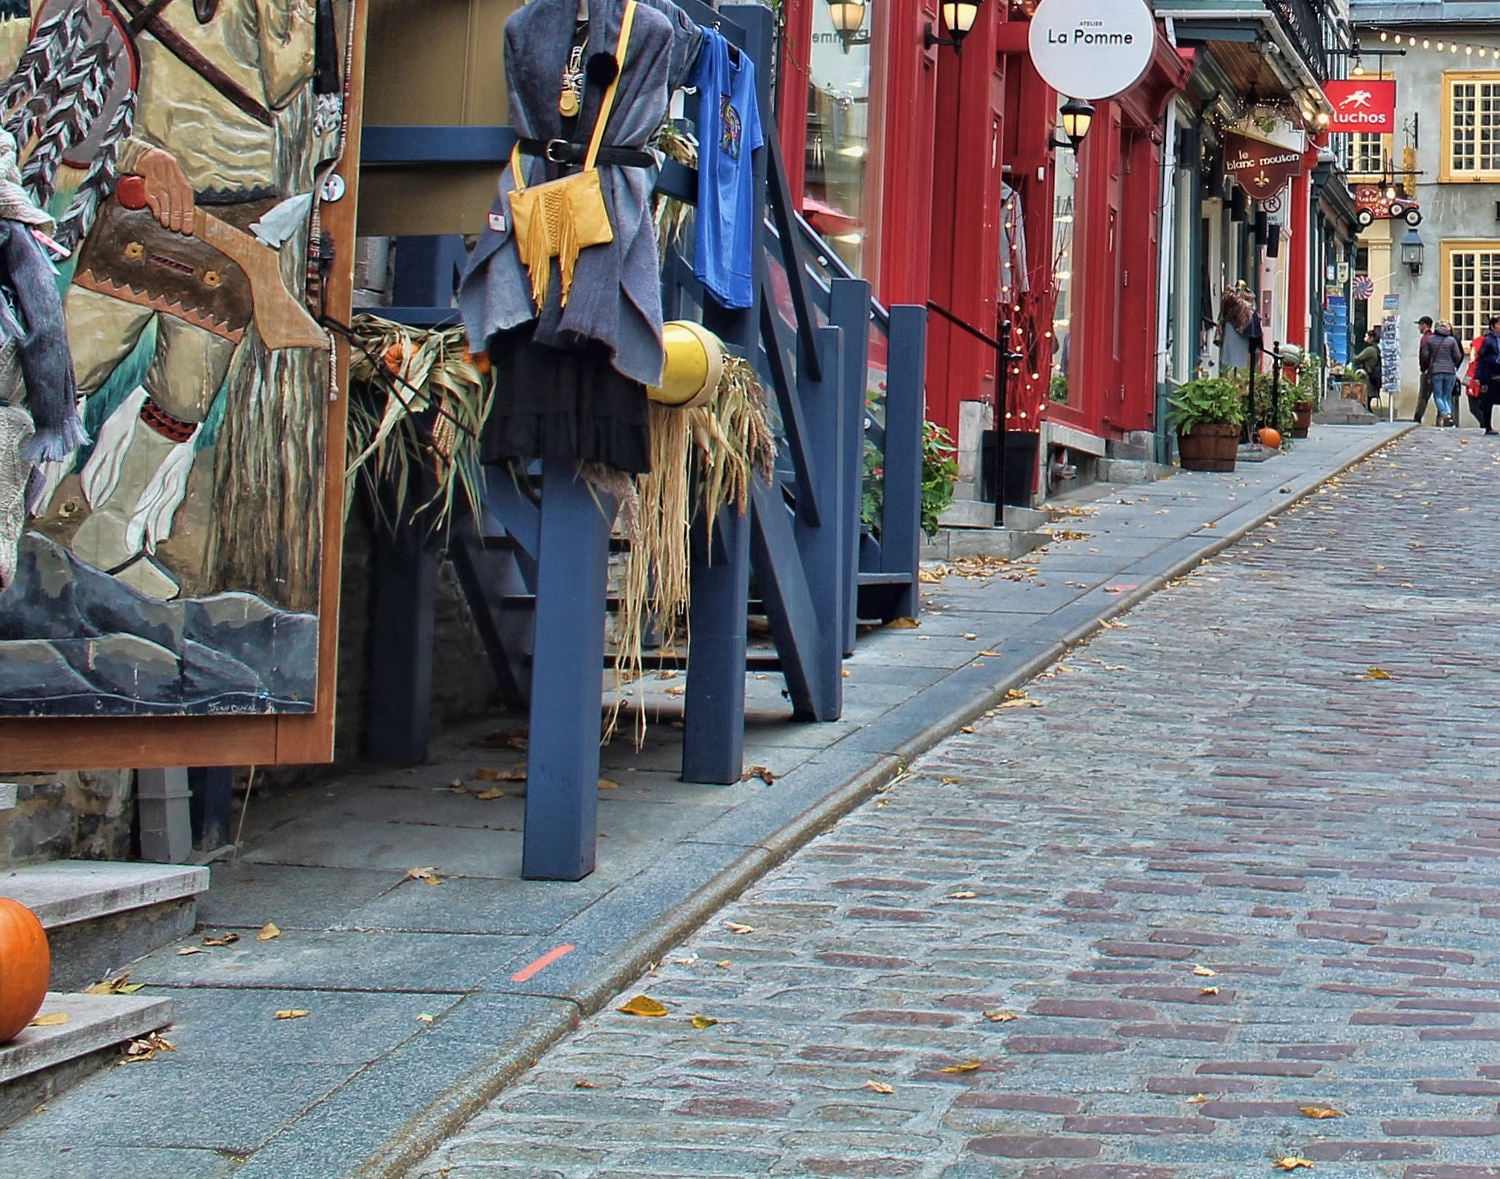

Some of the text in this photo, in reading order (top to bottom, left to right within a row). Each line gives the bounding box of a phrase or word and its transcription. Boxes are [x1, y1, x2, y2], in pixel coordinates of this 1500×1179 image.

[1048, 29, 1133, 44] La Pomme
[1238, 150, 1249, 160] le
[1226, 159, 1255, 171] blanc
